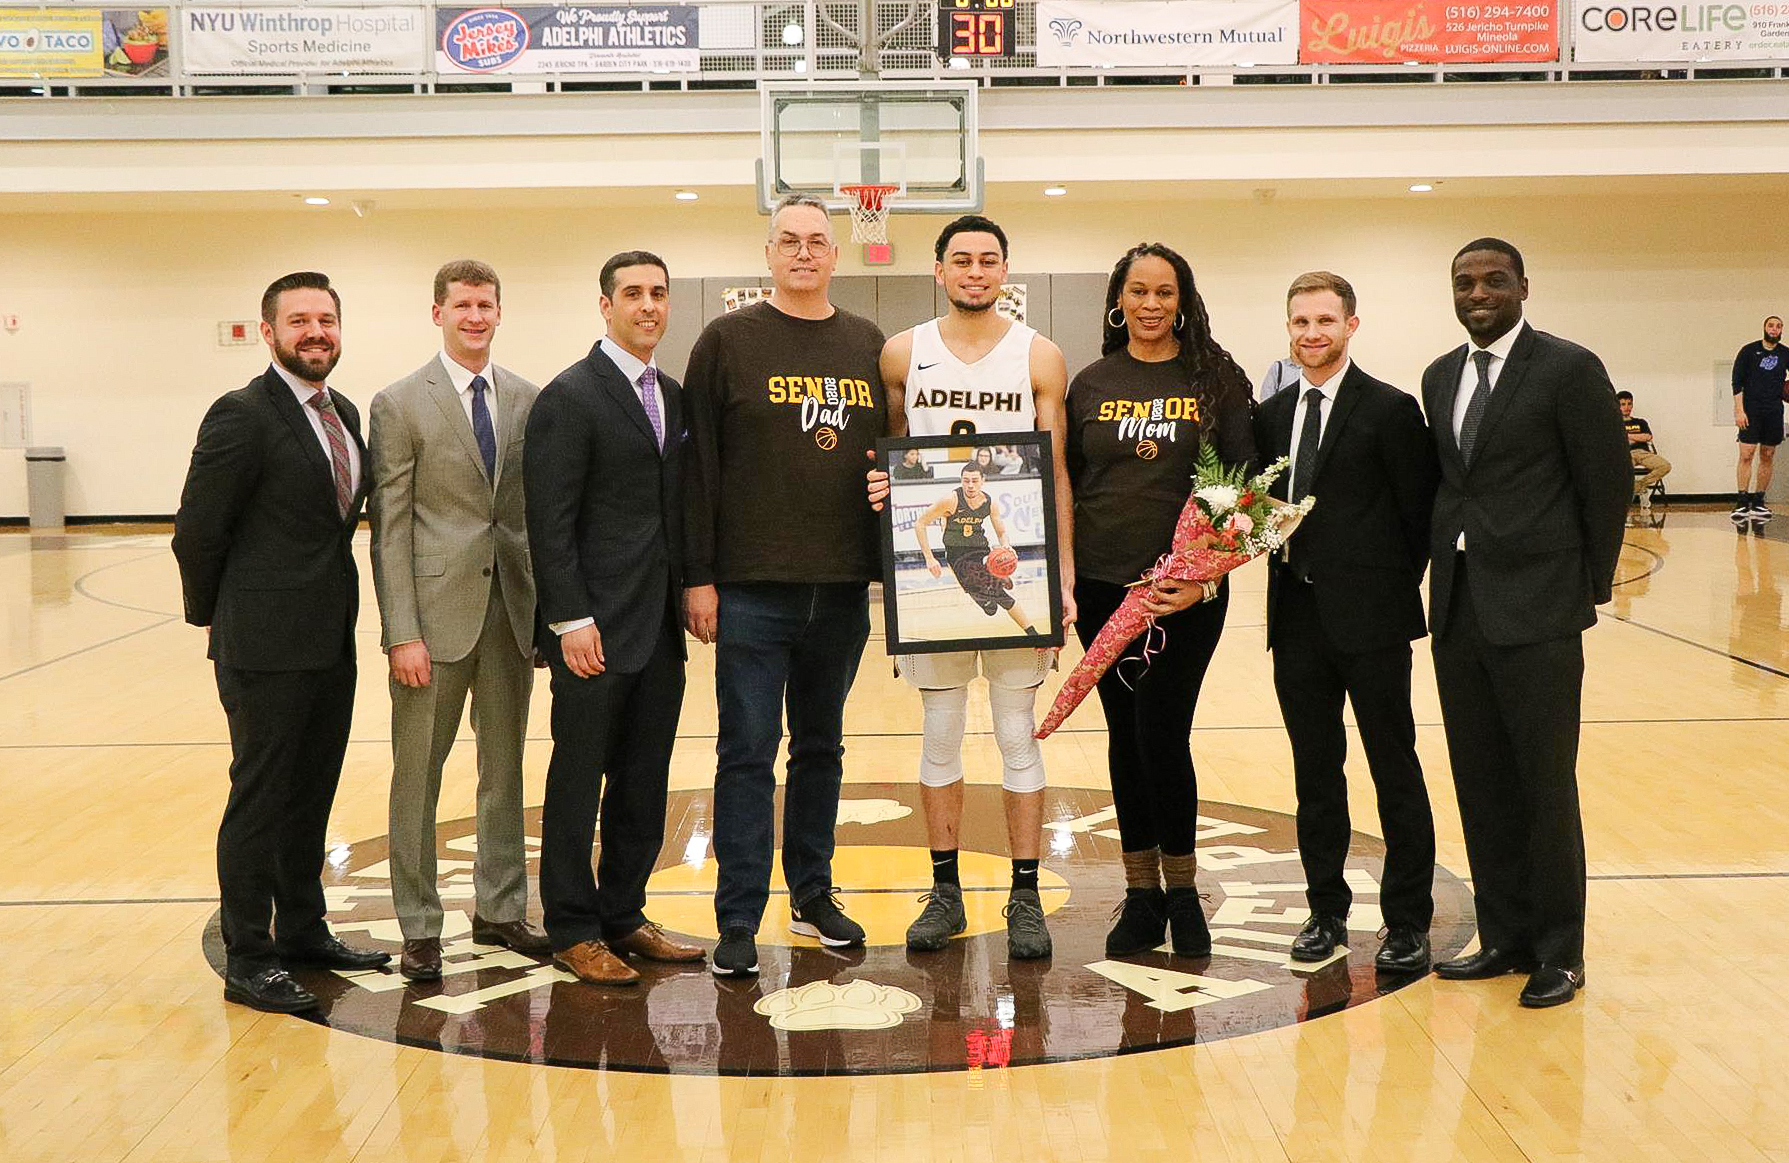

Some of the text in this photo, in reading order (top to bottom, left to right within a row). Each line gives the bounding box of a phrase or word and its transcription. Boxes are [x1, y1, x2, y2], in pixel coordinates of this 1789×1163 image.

[556, 8, 670, 27] We Proudly Support
[1445, 5, 1549, 19] (516) 294-7400
[190, 12, 415, 37] NYU Winthrop Hospital
[454, 21, 517, 43] Jersey
[1445, 21, 1549, 33] 526 Jericho Turnpike
[44, 35, 90, 48] TACO
[541, 25, 687, 47] ADELPHI ATHLETICS
[953, 14, 1001, 53] 30
[1087, 27, 1283, 44] Northwestern Mutual
[1476, 32, 1518, 42] Mineola
[247, 39, 372, 55] Sports Medicine
[1400, 43, 1439, 53] PIZZERIA
[1681, 41, 1743, 50] EATERY
[478, 56, 502, 67] SUBS
[912, 387, 1022, 412] ADELPHI
[801, 395, 851, 433] Dad
[1118, 415, 1176, 443] Mom
